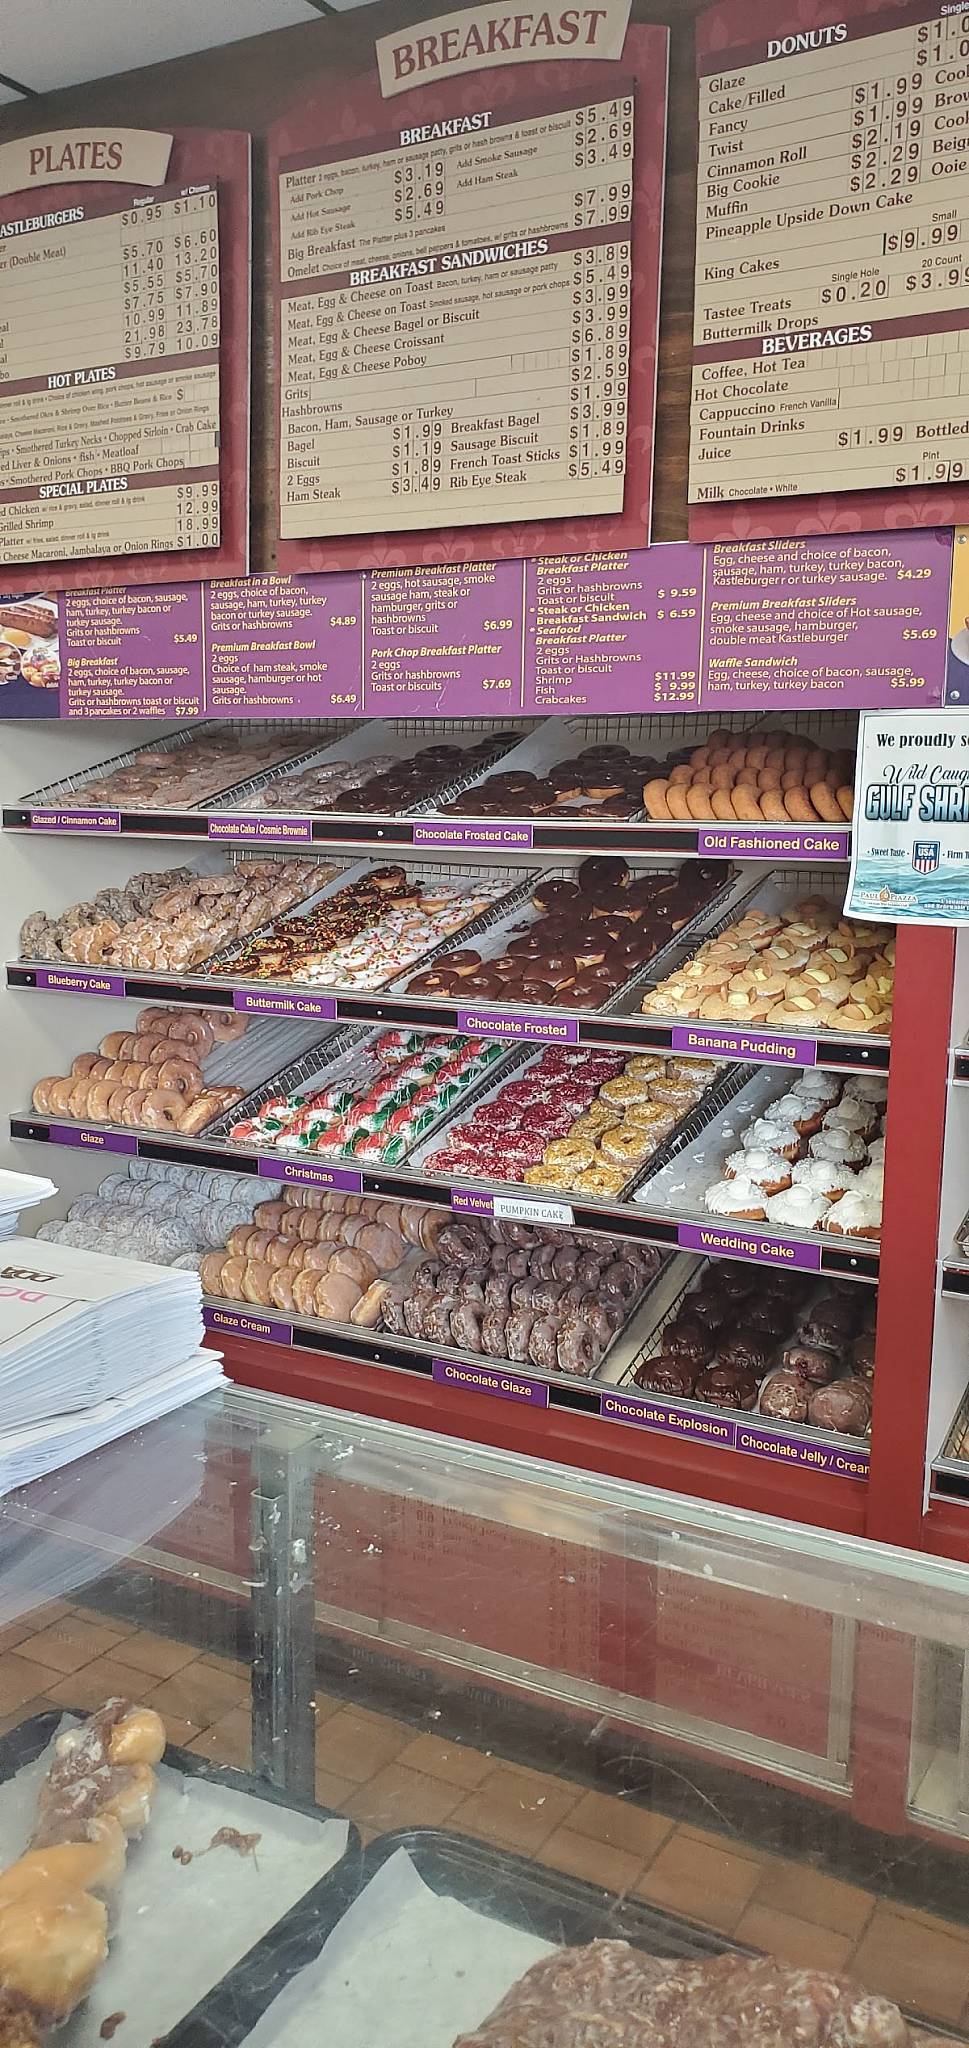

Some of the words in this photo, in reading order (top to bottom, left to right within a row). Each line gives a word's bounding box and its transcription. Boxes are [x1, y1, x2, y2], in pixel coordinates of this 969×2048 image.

[392, 10, 607, 80] BREAKFAST
[768, 24, 847, 58] DONUTS
[709, 75, 746, 93] Glaze
[855, 73, 922, 104] $1.99
[709, 85, 785, 114] Cake/Filled
[576, 101, 631, 126] $5.49
[400, 112, 492, 147] BREAKFAST
[575, 122, 631, 146] $2.69
[709, 118, 748, 136] Fancy
[575, 142, 631, 167] $3.49
[709, 139, 744, 157] Twist
[852, 143, 919, 170] $2.29
[30, 142, 123, 175] PLATES
[707, 156, 775, 178] Cinnamon
[780, 146, 807, 161] Roll
[707, 184, 728, 198] Big
[733, 174, 780, 192] Cookie
[122, 205, 162, 225] $0.95
[174, 194, 216, 214] $1.10
[706, 201, 748, 218] Muffin
[706, 218, 772, 239] Pineapple
[777, 208, 824, 227] Upside
[829, 200, 870, 217] Down
[876, 192, 913, 208] Cake
[932, 210, 957, 222] Small
[887, 224, 958, 251] $9.99
[288, 249, 304, 260] Big
[307, 239, 355, 257] Breakfast
[123, 257, 163, 277] 11.40
[176, 249, 217, 266] 13.20
[350, 258, 436, 286] BREAKFAST
[441, 238, 548, 270] SANDWICHES
[832, 272, 858, 282] Single
[860, 268, 879, 279] Hole
[822, 280, 885, 303] $0.20
[703, 323, 772, 341] Buttermilk
[777, 315, 819, 331] Drops
[762, 325, 872, 355] BEVERAGES
[48, 373, 71, 389] HOT
[75, 367, 116, 385] PLATES
[702, 365, 747, 380] Coffee,
[752, 362, 777, 374] Hot
[782, 358, 805, 370] Tea
[285, 389, 308, 400] Grits
[694, 388, 718, 401] Hot
[723, 381, 789, 397] Chocolate
[282, 404, 342, 417] Hashbrowns
[451, 419, 503, 433] Breakfast
[508, 413, 540, 428] Bagel
[570, 402, 625, 419] $3.99
[700, 404, 775, 421] Cappuccino
[780, 401, 807, 412] French
[810, 398, 836, 408] Vanilla
[699, 426, 756, 440] Fountain
[761, 420, 805, 434] Drinks
[839, 426, 902, 447] $1.99
[451, 437, 497, 451] Sausage
[500, 433, 538, 446] Biscuit
[450, 454, 487, 470] French
[492, 454, 522, 466] Toast
[526, 449, 560, 462] Sticks
[698, 448, 732, 461] Juice
[923, 451, 939, 459] Pint
[450, 476, 468, 488] Rib
[472, 473, 491, 486] Eye
[495, 470, 527, 483] Steak
[568, 459, 623, 477] $5.49
[896, 462, 963, 482] $1.99
[40, 482, 84, 498] SPECIAL
[87, 477, 128, 493] PLATES
[177, 483, 218, 498] $9.99
[287, 492, 310, 503] Ham
[313, 490, 341, 499] Steak
[697, 487, 724, 499] Milk
[25, 519, 54, 533] Shrimp
[177, 533, 218, 547] $1.00
[714, 542, 765, 554] Breakfast
[768, 540, 806, 551] Sliders
[897, 569, 931, 580] $4.29
[174, 634, 197, 643] $5.49
[536, 625, 581, 635] Seafood
[212, 643, 249, 652] Premium
[251, 641, 292, 650] Breakfast
[294, 640, 316, 649] Bowl
[371, 648, 393, 658] Pork
[395, 647, 418, 658] Chop
[420, 646, 466, 656] Breakfast
[468, 645, 502, 654] Platter
[67, 658, 80, 667] Big
[81, 657, 118, 666] Breakfast
[709, 658, 742, 668] Waffle
[744, 657, 798, 667] Sandwich
[482, 679, 511, 689] $7.69
[877, 734, 895, 746] We
[899, 734, 955, 749] proudly
[883, 764, 928, 784] Wild
[930, 765, 969, 786] Caug
[865, 784, 915, 821] GULF
[61, 816, 97, 824] Cinnamon
[99, 817, 116, 825] Cake
[210, 823, 239, 833] Chocolate
[240, 824, 255, 833] Cake
[260, 825, 281, 834] Cosmic
[283, 825, 307, 835] Brownie
[415, 829, 462, 841] Chocolate
[465, 829, 500, 841] Frosted
[503, 831, 529, 842] Cake
[704, 835, 726, 849] Old
[730, 836, 800, 850] Fashioned
[804, 837, 839, 851] Cake
[871, 848, 889, 856] Sweet
[947, 850, 963, 859] Firm
[48, 975, 88, 989] Blueberry
[89, 979, 110, 991] Cake
[246, 996, 295, 1012] Buttermilk
[297, 1000, 321, 1013] Cake
[466, 1017, 522, 1032] Chocolate
[524, 1022, 567, 1035] Frosted
[688, 1034, 737, 1051] Banana
[740, 1039, 796, 1058] Pudding
[80, 1133, 104, 1145] Glaze
[285, 1166, 333, 1183] Christmas
[453, 1196, 468, 1205] Red
[470, 1197, 493, 1209] Velvet
[501, 1205, 539, 1216] PUMPKIN
[542, 1210, 563, 1219] CAKE
[700, 1231, 757, 1254] Wedding
[760, 1241, 794, 1258] Cake
[213, 1312, 238, 1328] Glaze
[241, 1317, 271, 1334] Cream
[445, 1366, 498, 1388] Chocolate
[501, 1377, 532, 1396] Glaze
[605, 1399, 665, 1422] Chocolate
[668, 1414, 728, 1437] Explosion
[741, 1435, 798, 1457] Chocolate
[800, 1450, 827, 1467] Jelly
